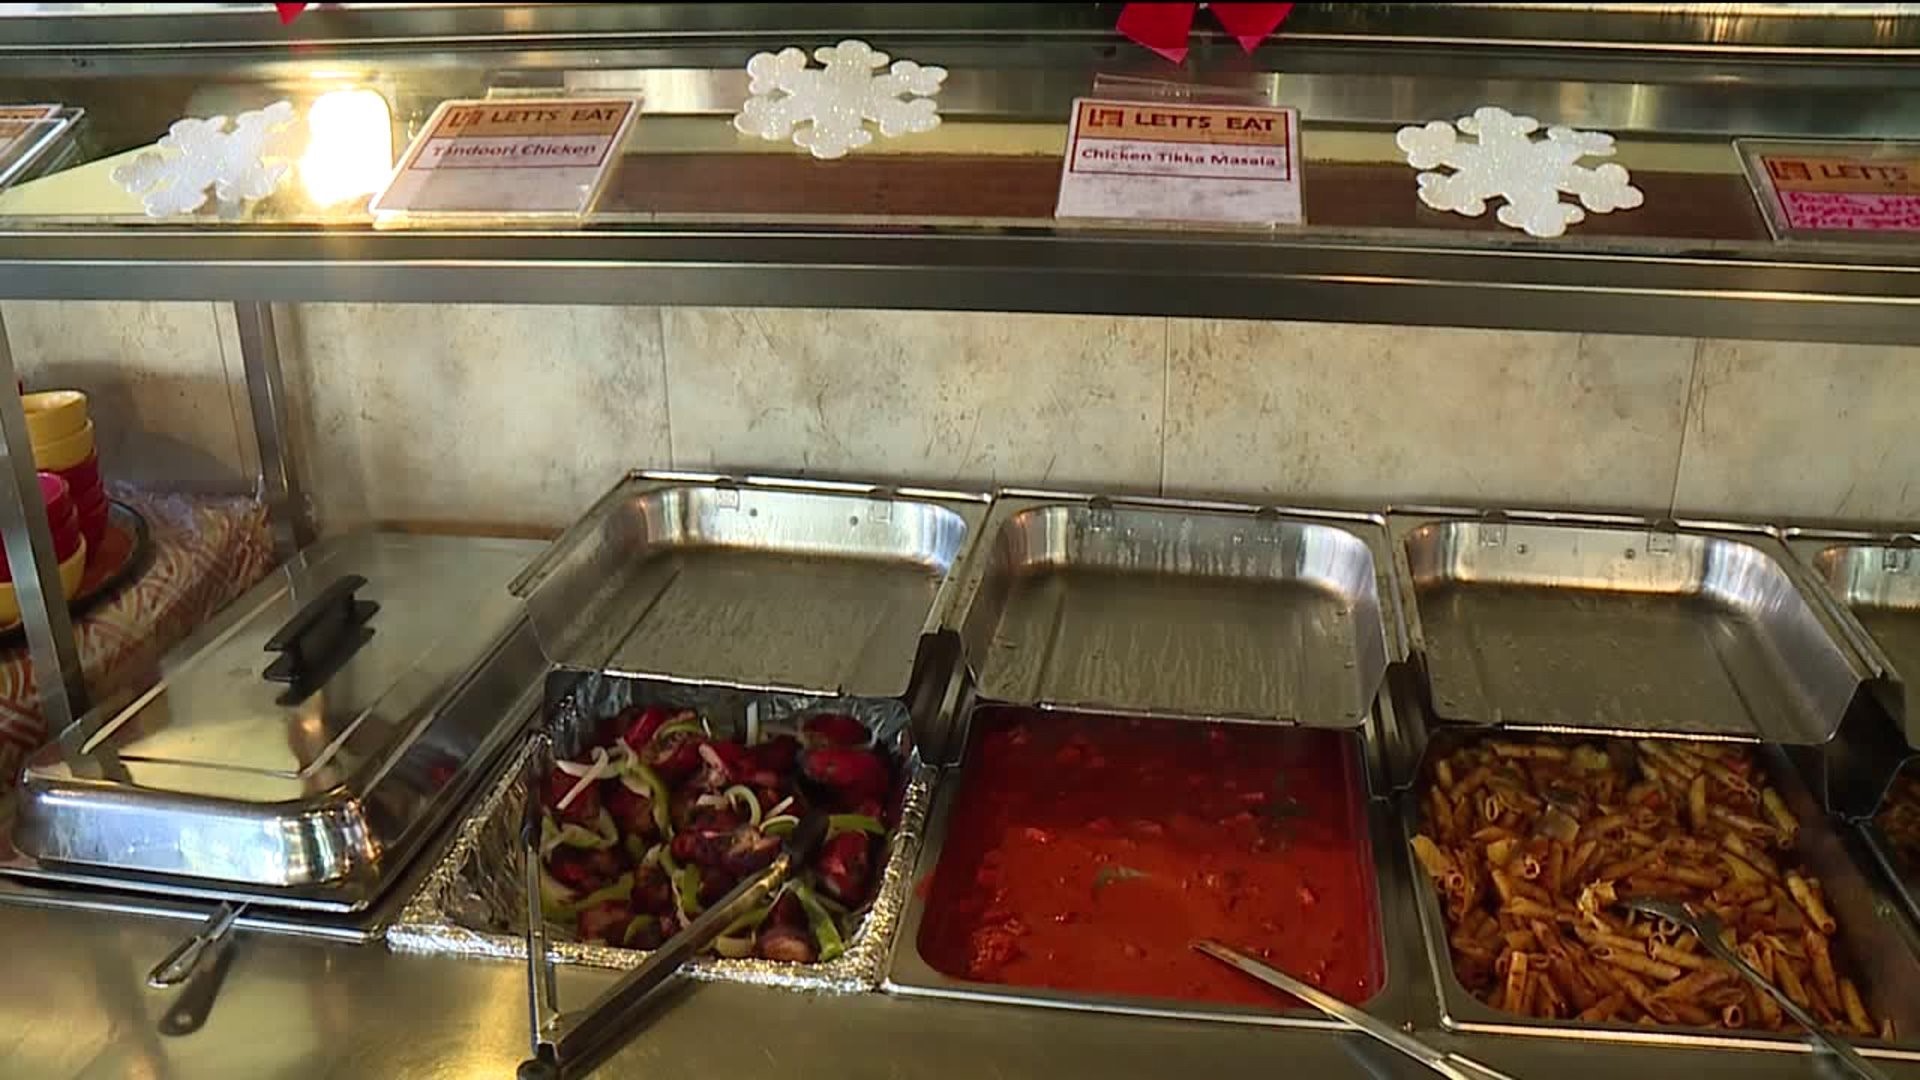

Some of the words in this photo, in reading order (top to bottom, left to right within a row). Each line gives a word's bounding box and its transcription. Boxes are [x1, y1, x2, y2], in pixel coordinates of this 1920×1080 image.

[491, 109, 560, 123] LETTS
[570, 108, 619, 122] EAT
[1136, 112, 1212, 129] LETTS
[1226, 116, 1276, 131] EAT
[521, 142, 597, 156] Chicken
[1082, 148, 1151, 161] Chicken
[1157, 152, 1205, 165] Tikka
[1211, 154, 1276, 167] Masala
[1820, 164, 1909, 181] LETTS
